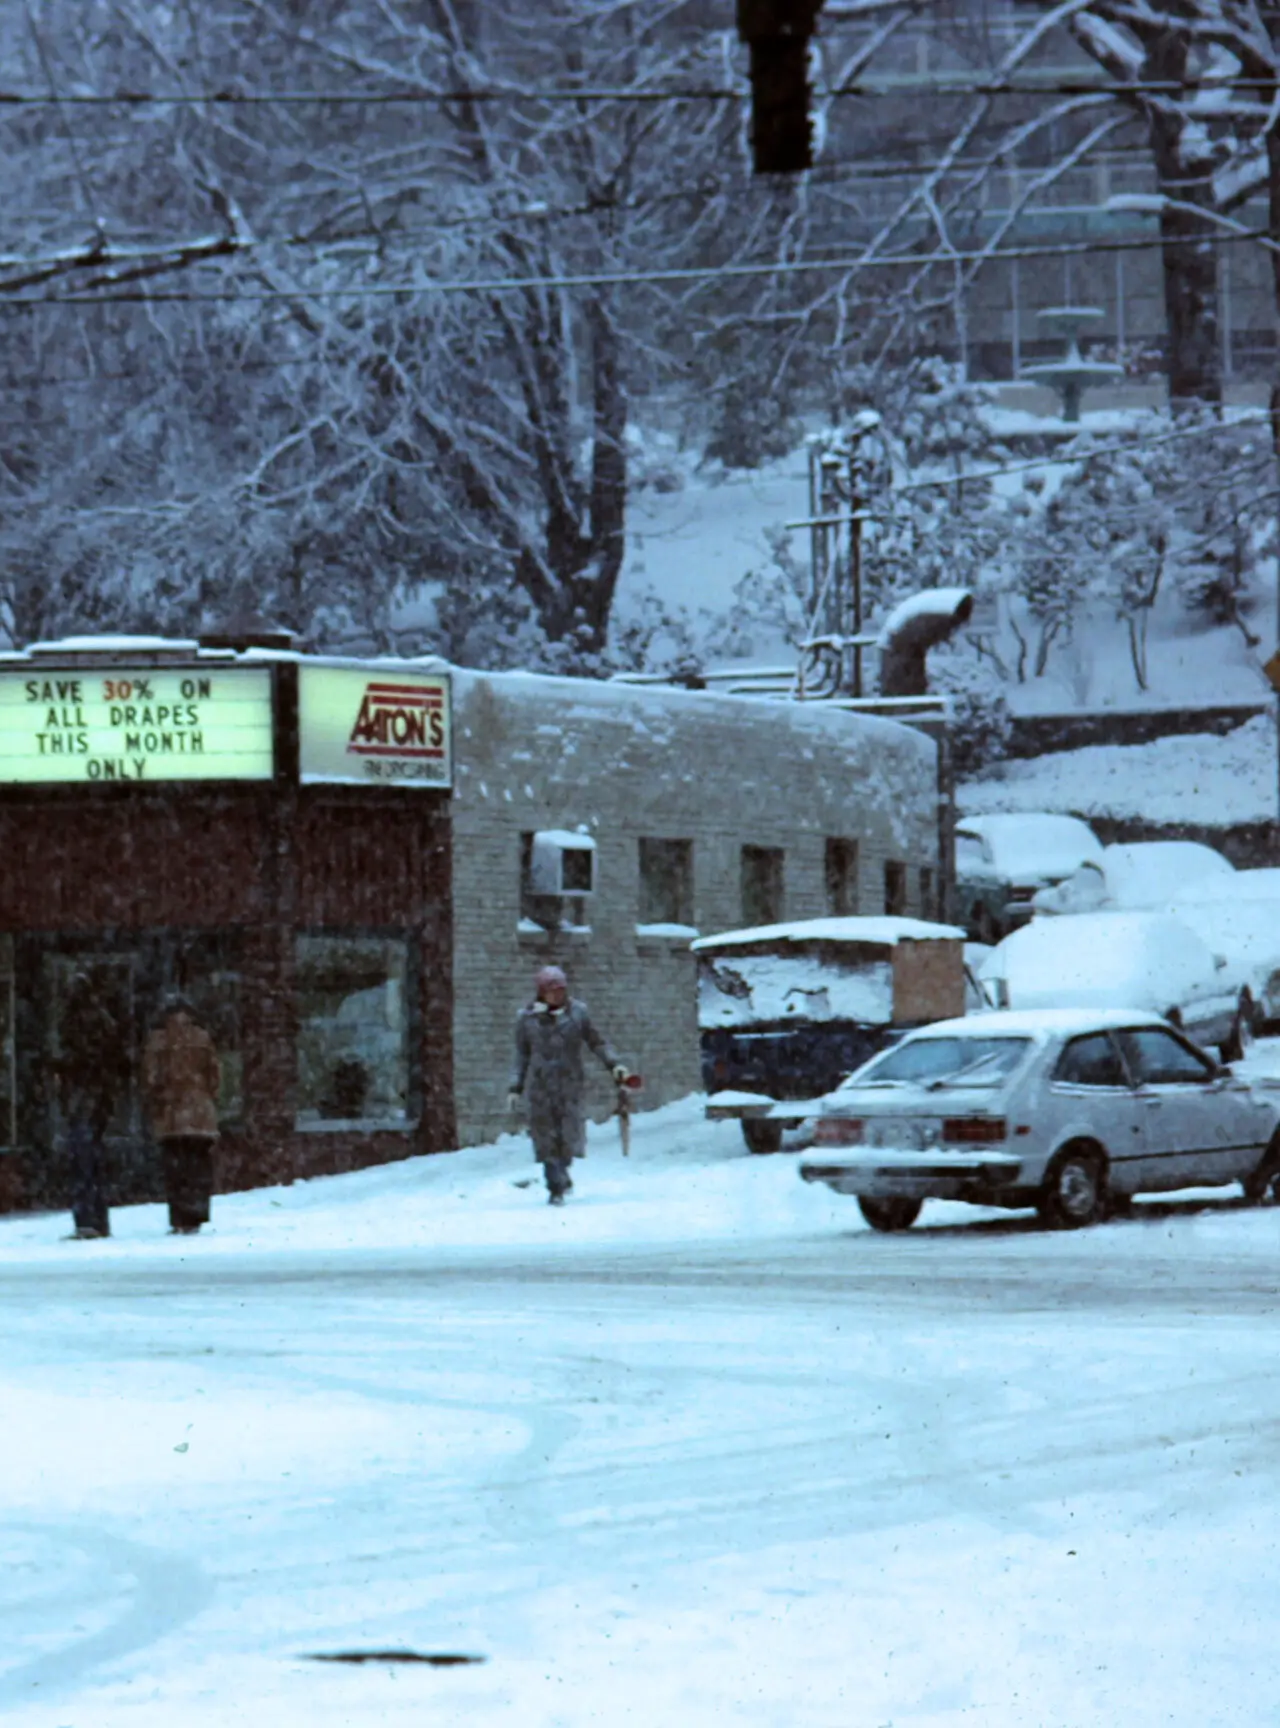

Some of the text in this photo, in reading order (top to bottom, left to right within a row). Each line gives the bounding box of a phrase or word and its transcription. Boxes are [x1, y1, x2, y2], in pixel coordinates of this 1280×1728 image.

[24, 679, 212, 702] SAVE 30% ON
[45, 704, 199, 728] ALL DRAPES
[35, 732, 204, 754] THIS MONTH
[86, 758, 146, 780] ONLY
